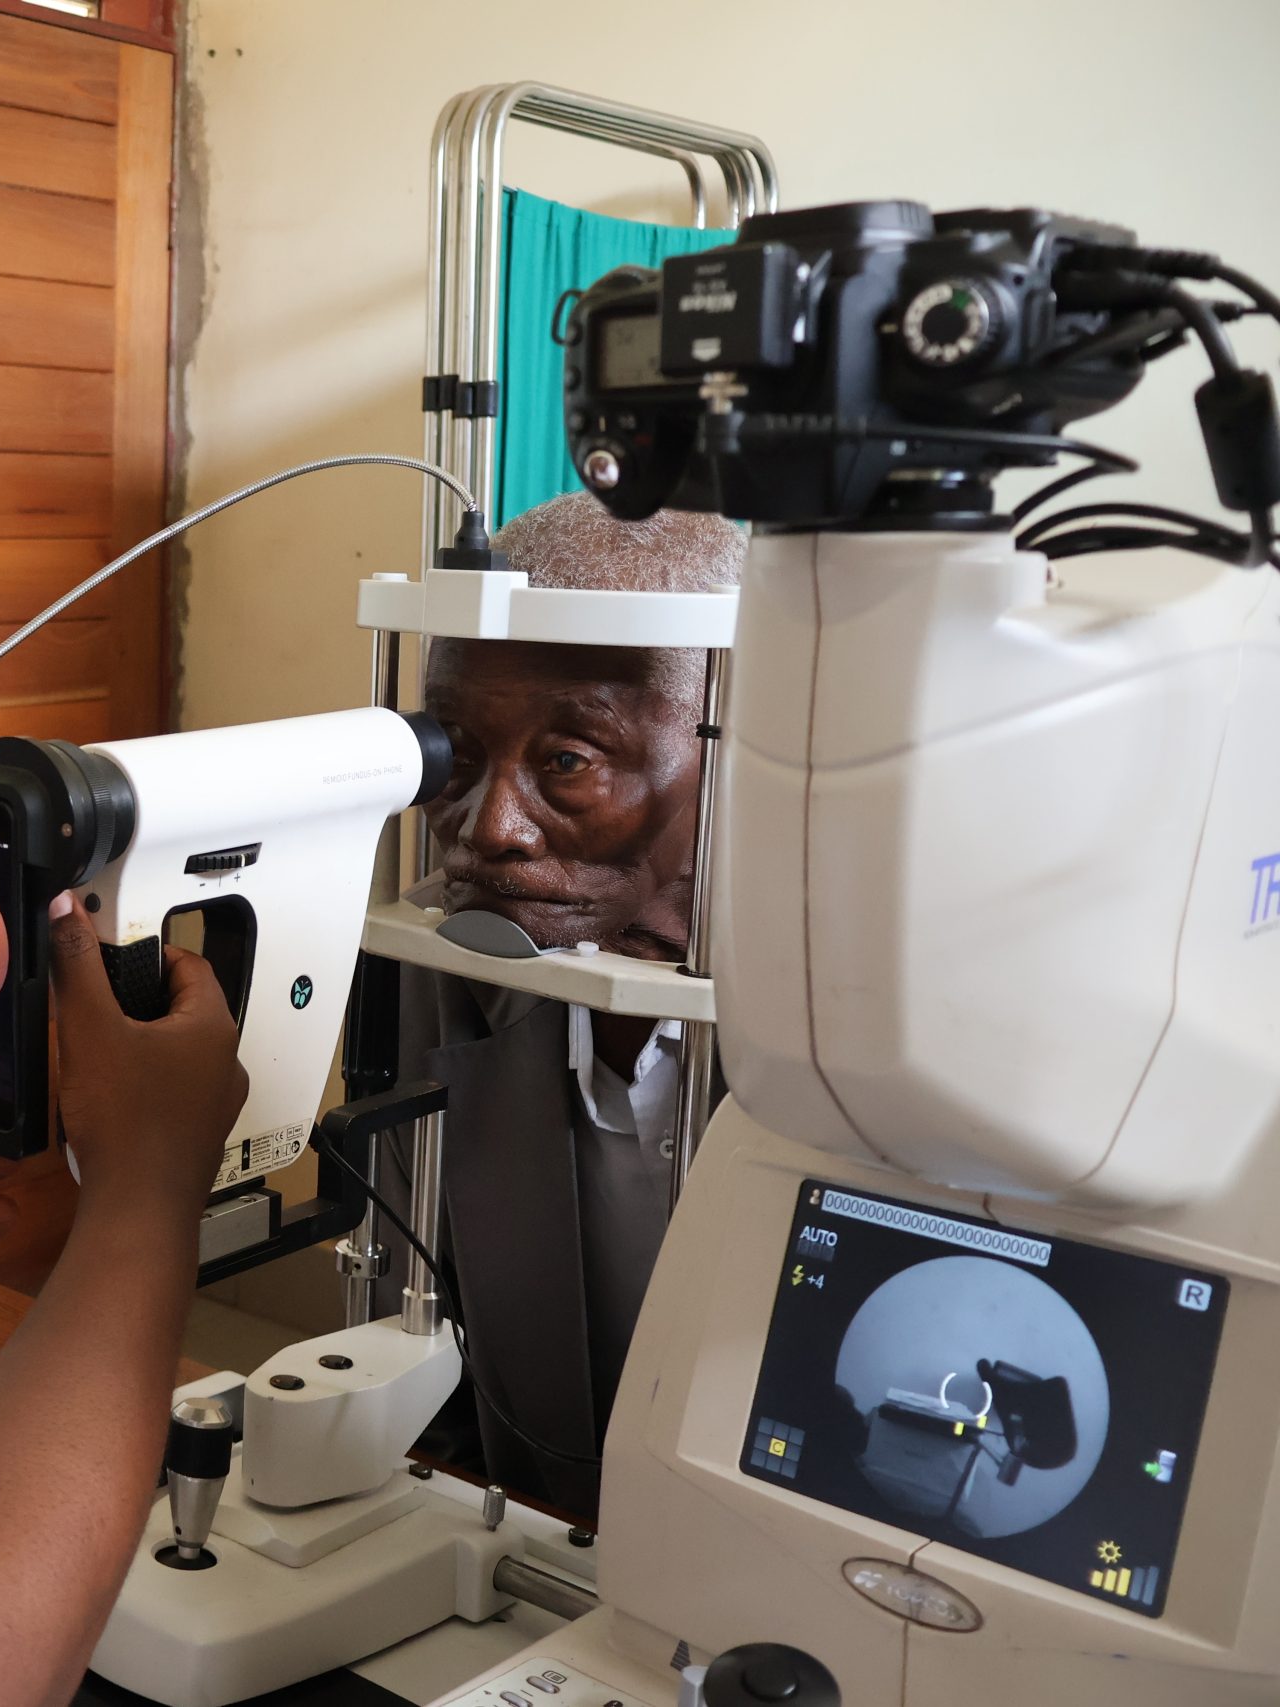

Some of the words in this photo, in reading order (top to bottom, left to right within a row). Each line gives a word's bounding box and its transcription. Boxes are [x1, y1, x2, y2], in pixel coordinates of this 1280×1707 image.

[799, 1224, 838, 1248] AUTO
[807, 1273, 825, 1289] +4
[1185, 1284, 1204, 1306] R
